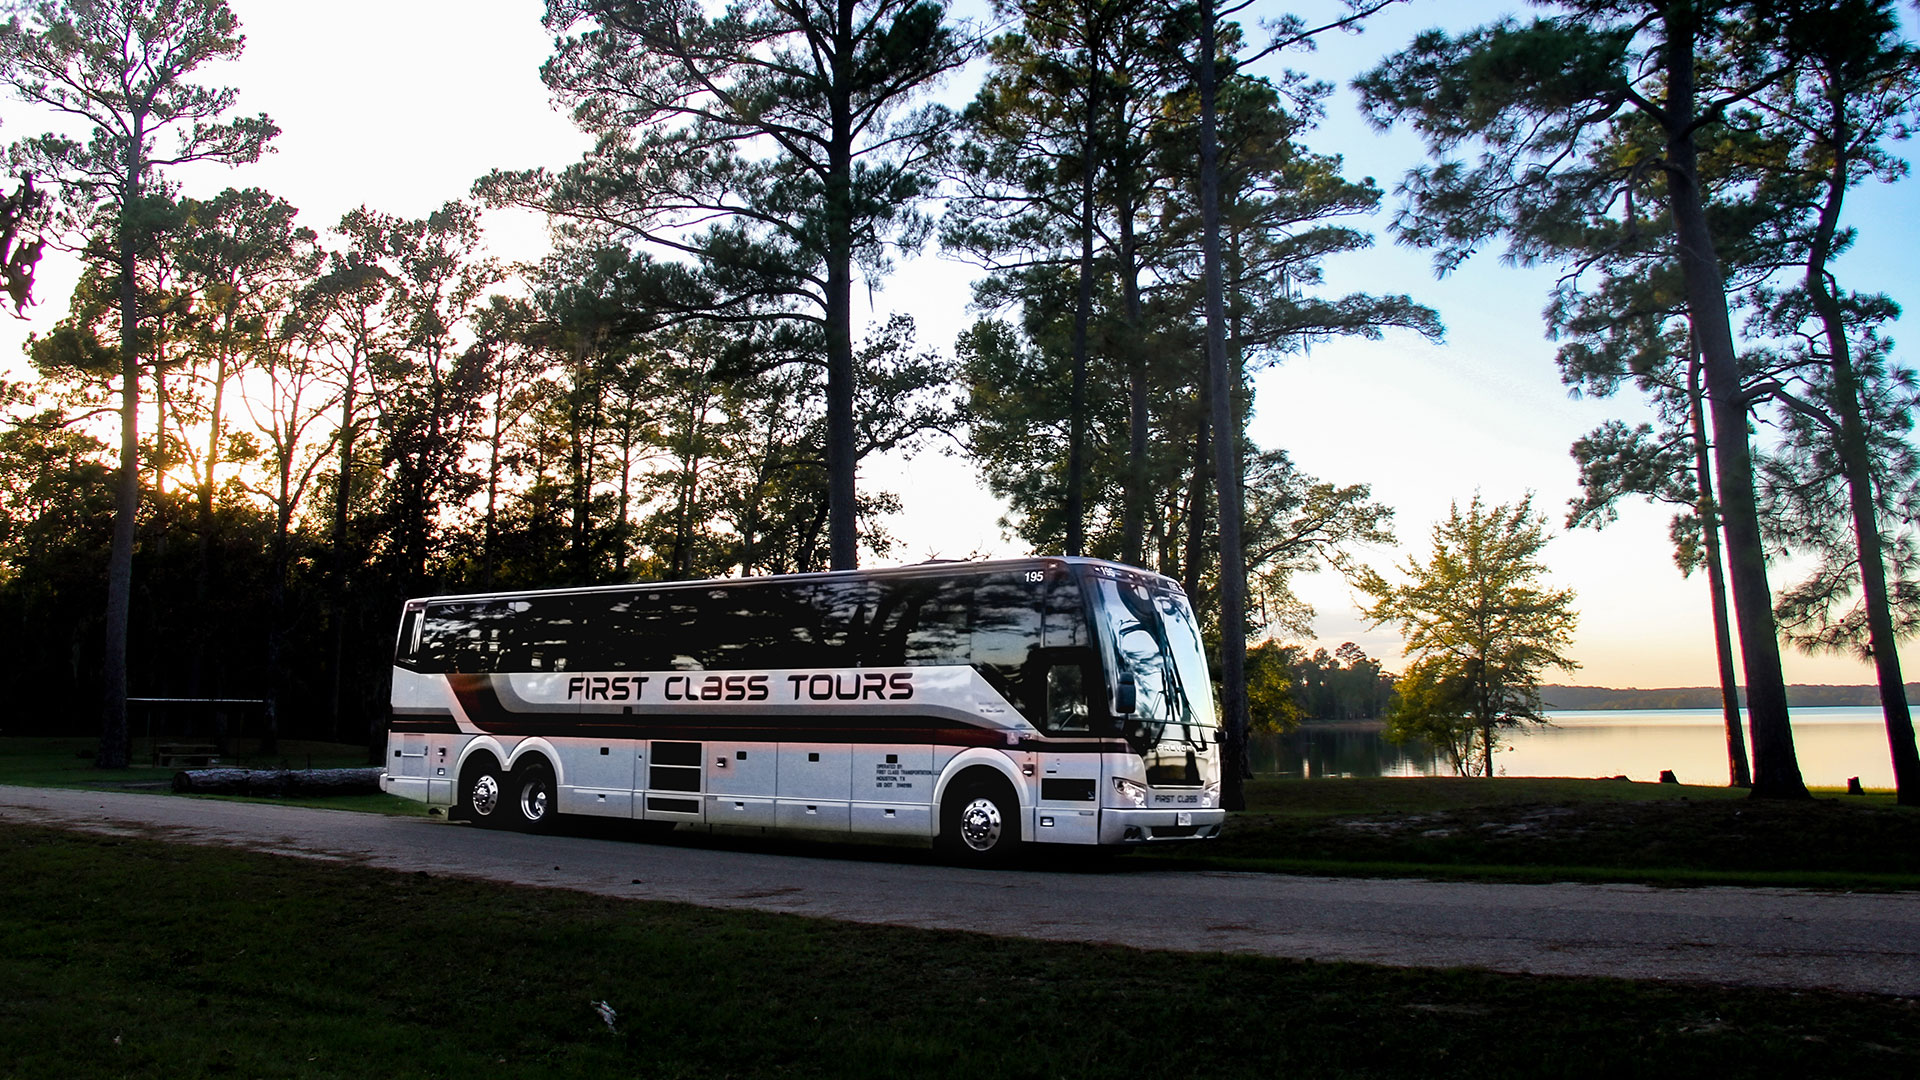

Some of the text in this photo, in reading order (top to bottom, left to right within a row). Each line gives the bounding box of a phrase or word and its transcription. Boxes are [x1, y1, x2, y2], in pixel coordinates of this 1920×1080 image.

[1024, 571, 1044, 583] 195
[1100, 566, 1116, 578] 195
[568, 676, 650, 701] FIRST
[787, 672, 914, 701] TOURS
[1154, 794, 1175, 803] FIRST
